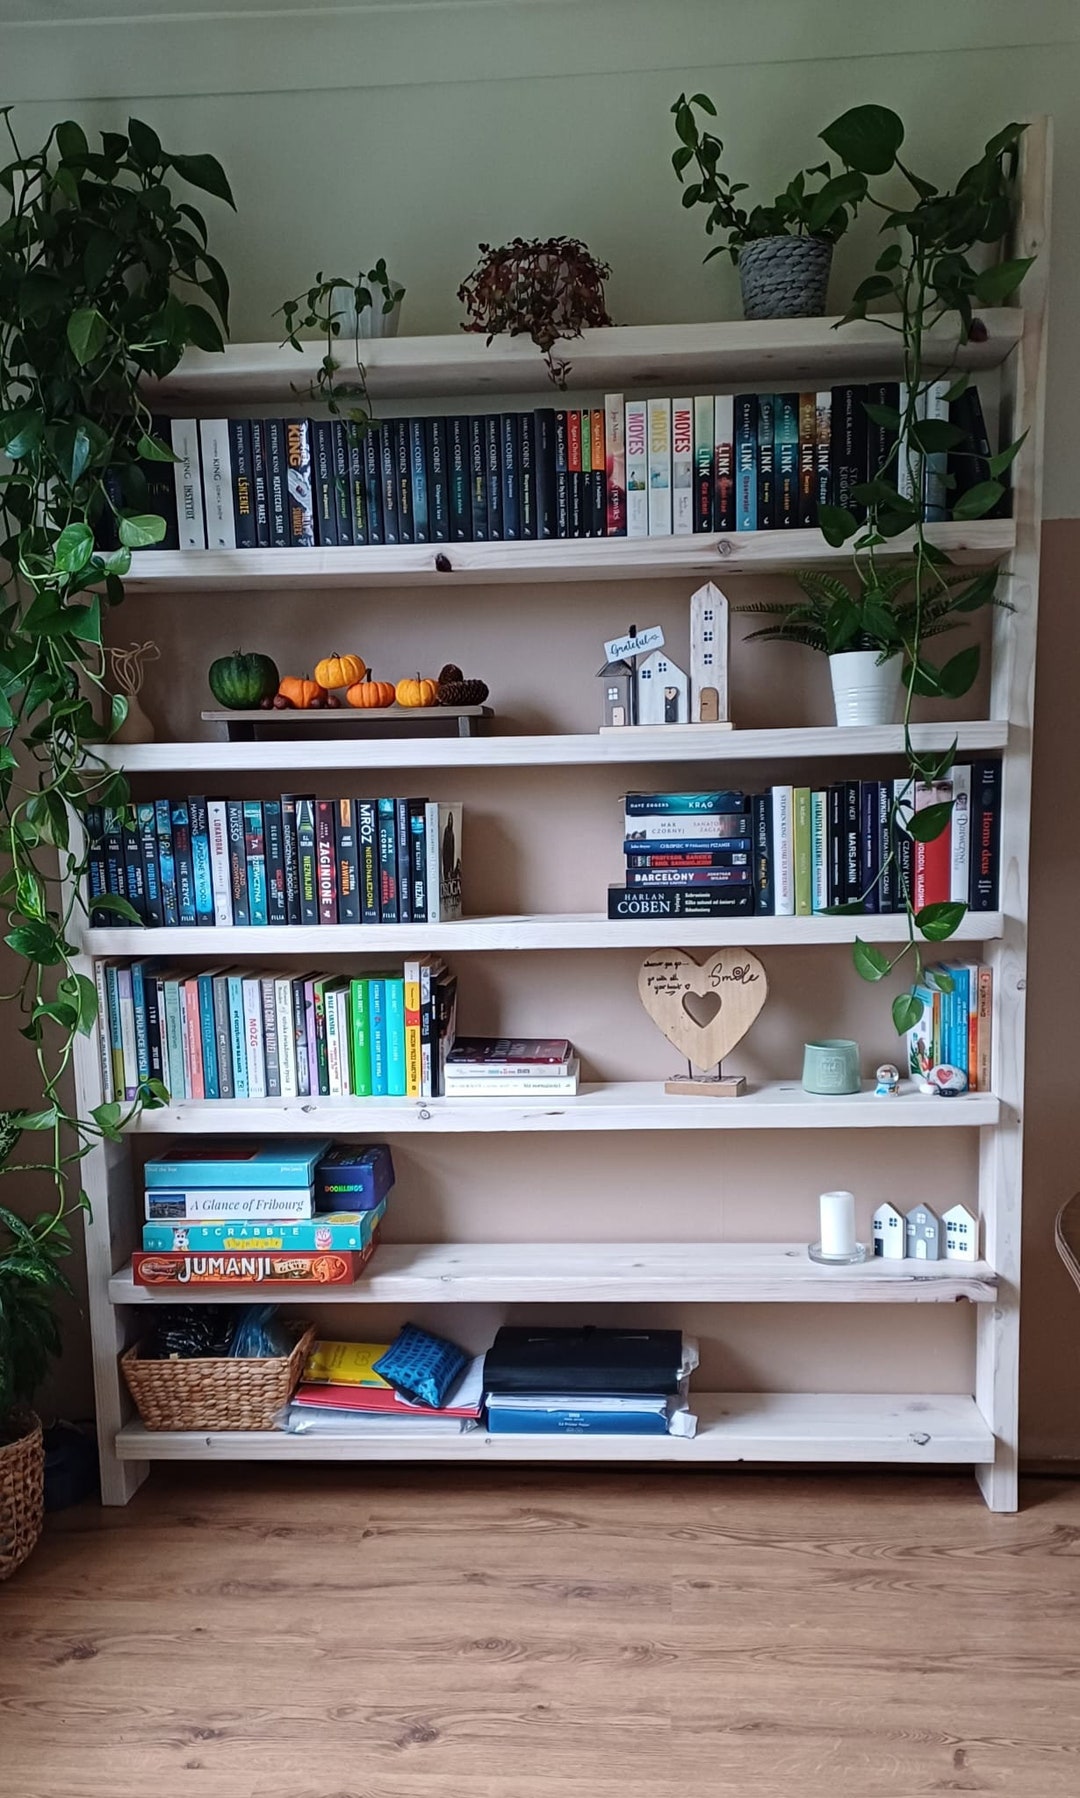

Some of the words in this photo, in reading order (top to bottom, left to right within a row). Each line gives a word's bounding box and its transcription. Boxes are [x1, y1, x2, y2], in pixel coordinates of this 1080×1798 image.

[628, 413, 644, 455] MOYES
[652, 410, 667, 453] MOYES
[675, 410, 690, 453] MOYES
[743, 403, 751, 438] Charlotte
[763, 405, 771, 439] Charlotte
[236, 425, 244, 453] STEPHEN
[253, 424, 261, 453] STEPHEN
[270, 424, 278, 454] STEPHEN
[287, 424, 301, 466] KING
[183, 457, 191, 479] KING
[255, 454, 263, 471] KING
[319, 452, 328, 479] COBEN
[337, 447, 345, 474] COBEN
[352, 448, 360, 475] COBEN
[368, 447, 376, 474] COBEN
[384, 448, 392, 474] COBEN
[414, 447, 422, 473] COBEN
[433, 446, 441, 473] COBEN
[490, 444, 498, 471] COBEN
[506, 442, 514, 470] COBEN
[523, 441, 532, 468] COBEN
[699, 448, 710, 477] LINK
[718, 446, 729, 476] LINK
[741, 443, 752, 472] LINK
[761, 444, 772, 473] LINK
[781, 444, 792, 473] LINK
[802, 443, 813, 472] LINK
[817, 443, 829, 472] LINK
[213, 458, 221, 481] KING
[184, 485, 195, 520] INSTYTUT
[238, 477, 250, 515] LŚNIENIE
[256, 477, 264, 500] WIELKI
[273, 476, 283, 513] MIASTECZKO
[275, 515, 284, 534] SALEM
[610, 634, 650, 657] Grateful
[190, 803, 199, 836] HAWKINS
[197, 808, 205, 830] PAULA
[780, 794, 788, 822] STEPHEN
[880, 787, 888, 824] HAWKING
[213, 819, 223, 855] LOKATORKA
[229, 807, 239, 842] MUSSO
[360, 804, 375, 844] MRÓZ
[759, 822, 767, 847] COBEN
[982, 811, 993, 846] Homo
[251, 839, 259, 849] TA
[380, 829, 388, 863] CZORNYJ
[848, 832, 857, 883] MARSJANIN
[902, 840, 910, 870] CZARNY
[180, 861, 188, 875] NIE
[319, 841, 332, 905] ZAGINIONE
[981, 850, 992, 875] deus
[127, 865, 137, 898] WRÓCIĆ
[182, 878, 190, 906] KRZYCZ
[252, 855, 261, 903] DZIEWCZYNA
[303, 855, 313, 901] NIEZNAJOMI
[341, 860, 350, 896] ZAWINIŁA
[635, 874, 695, 882] BARCELONY
[415, 881, 425, 908] RZEŹNIK
[617, 901, 670, 914] COBEN
[708, 963, 759, 987] Smile
[135, 1006, 143, 1014] W
[264, 1010, 275, 1031] CORAZ
[136, 1015, 146, 1048] PUŁAPCE
[249, 1018, 258, 1046] MÓZG
[265, 1032, 276, 1053] BLIŻEJ
[138, 1048, 149, 1071] MYŚLI
[190, 1200, 199, 1210] A
[200, 1199, 240, 1211] Glance
[242, 1199, 254, 1213] of
[255, 1198, 304, 1212] Fribourg
[202, 1227, 300, 1236] SCRABBLE
[177, 1256, 272, 1283] JUMANJI
[279, 1263, 307, 1272] GAME
